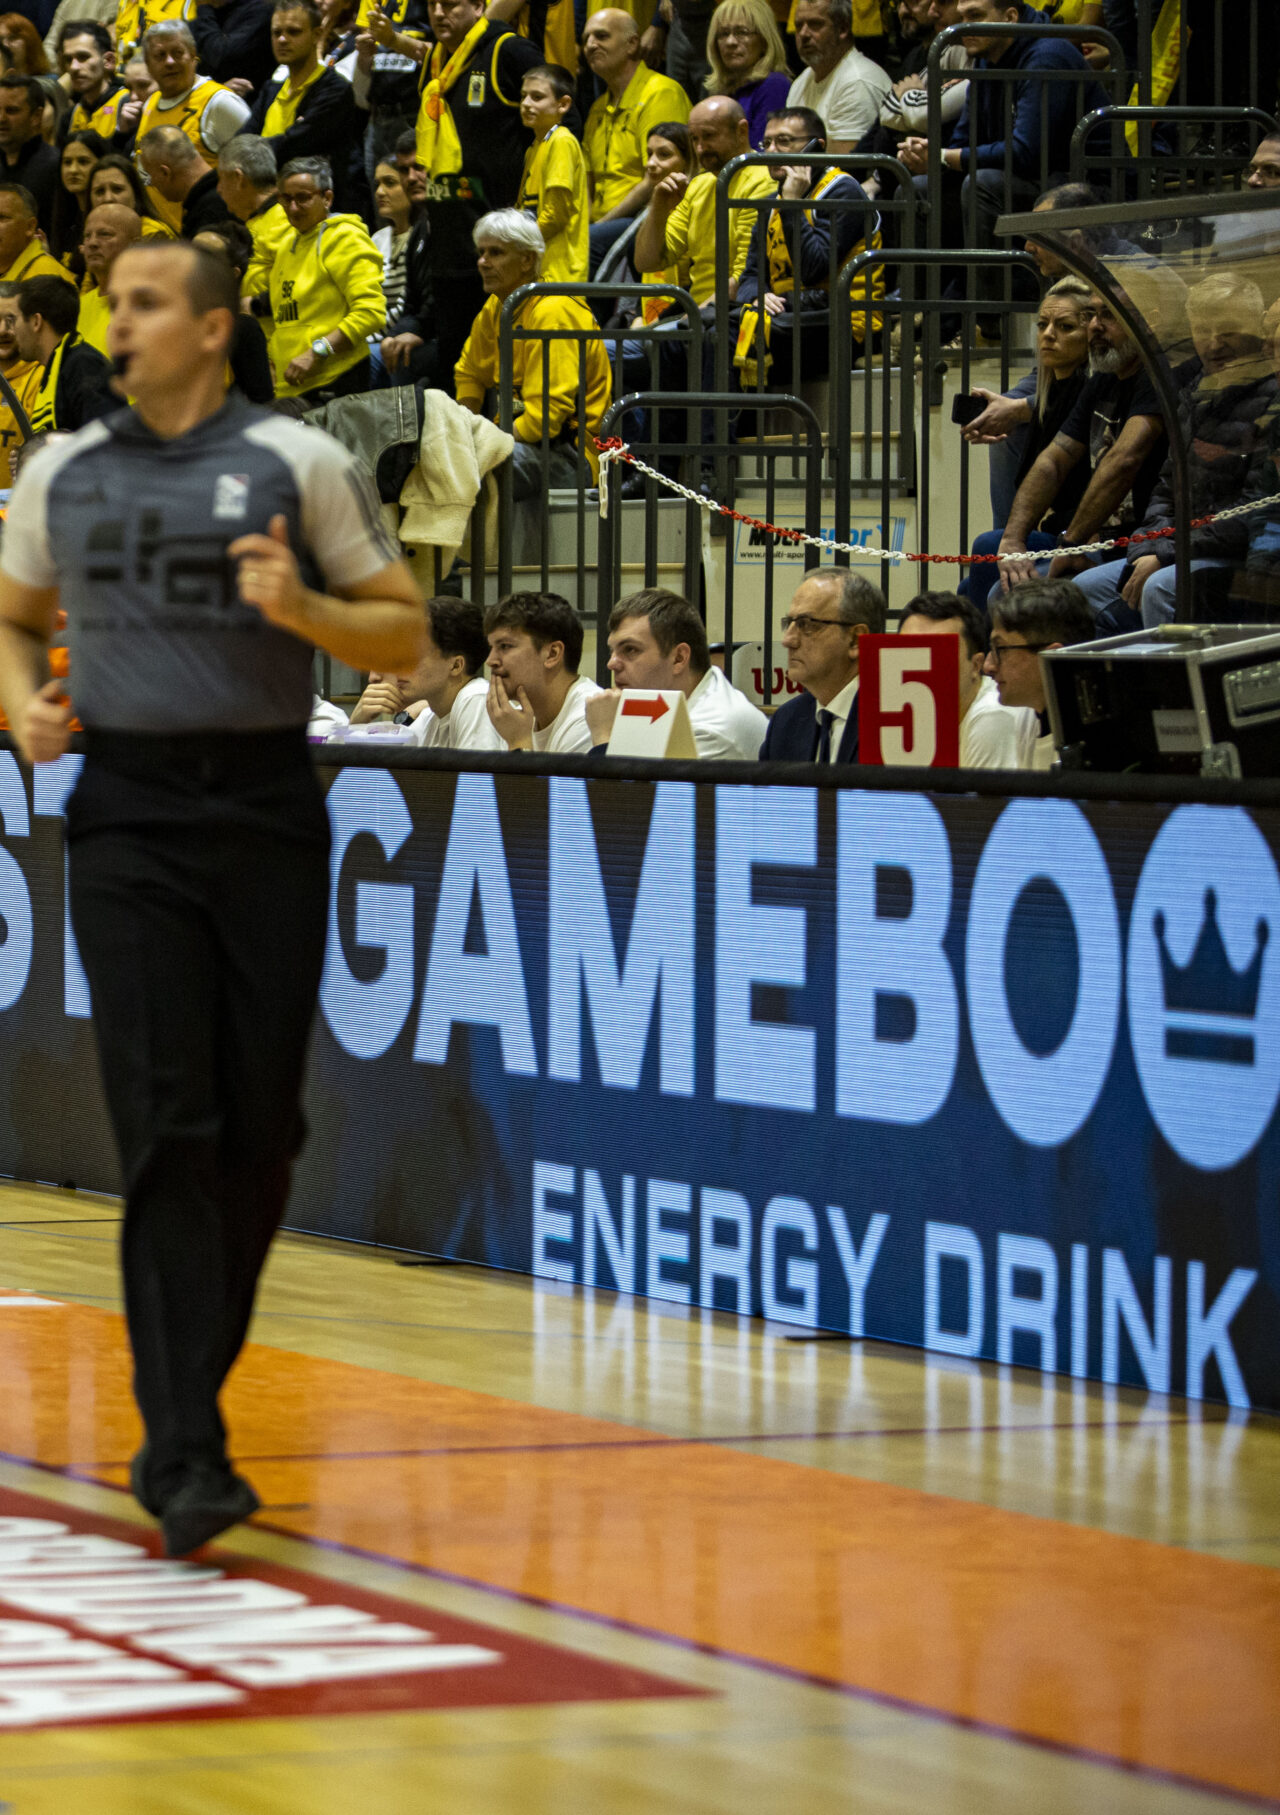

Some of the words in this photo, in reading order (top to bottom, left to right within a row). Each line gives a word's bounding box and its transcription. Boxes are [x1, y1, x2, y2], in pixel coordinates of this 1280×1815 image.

[879, 647, 937, 768] 5
[532, 1160, 890, 1338] ENERGY
[924, 1220, 1259, 1413] DRINK
